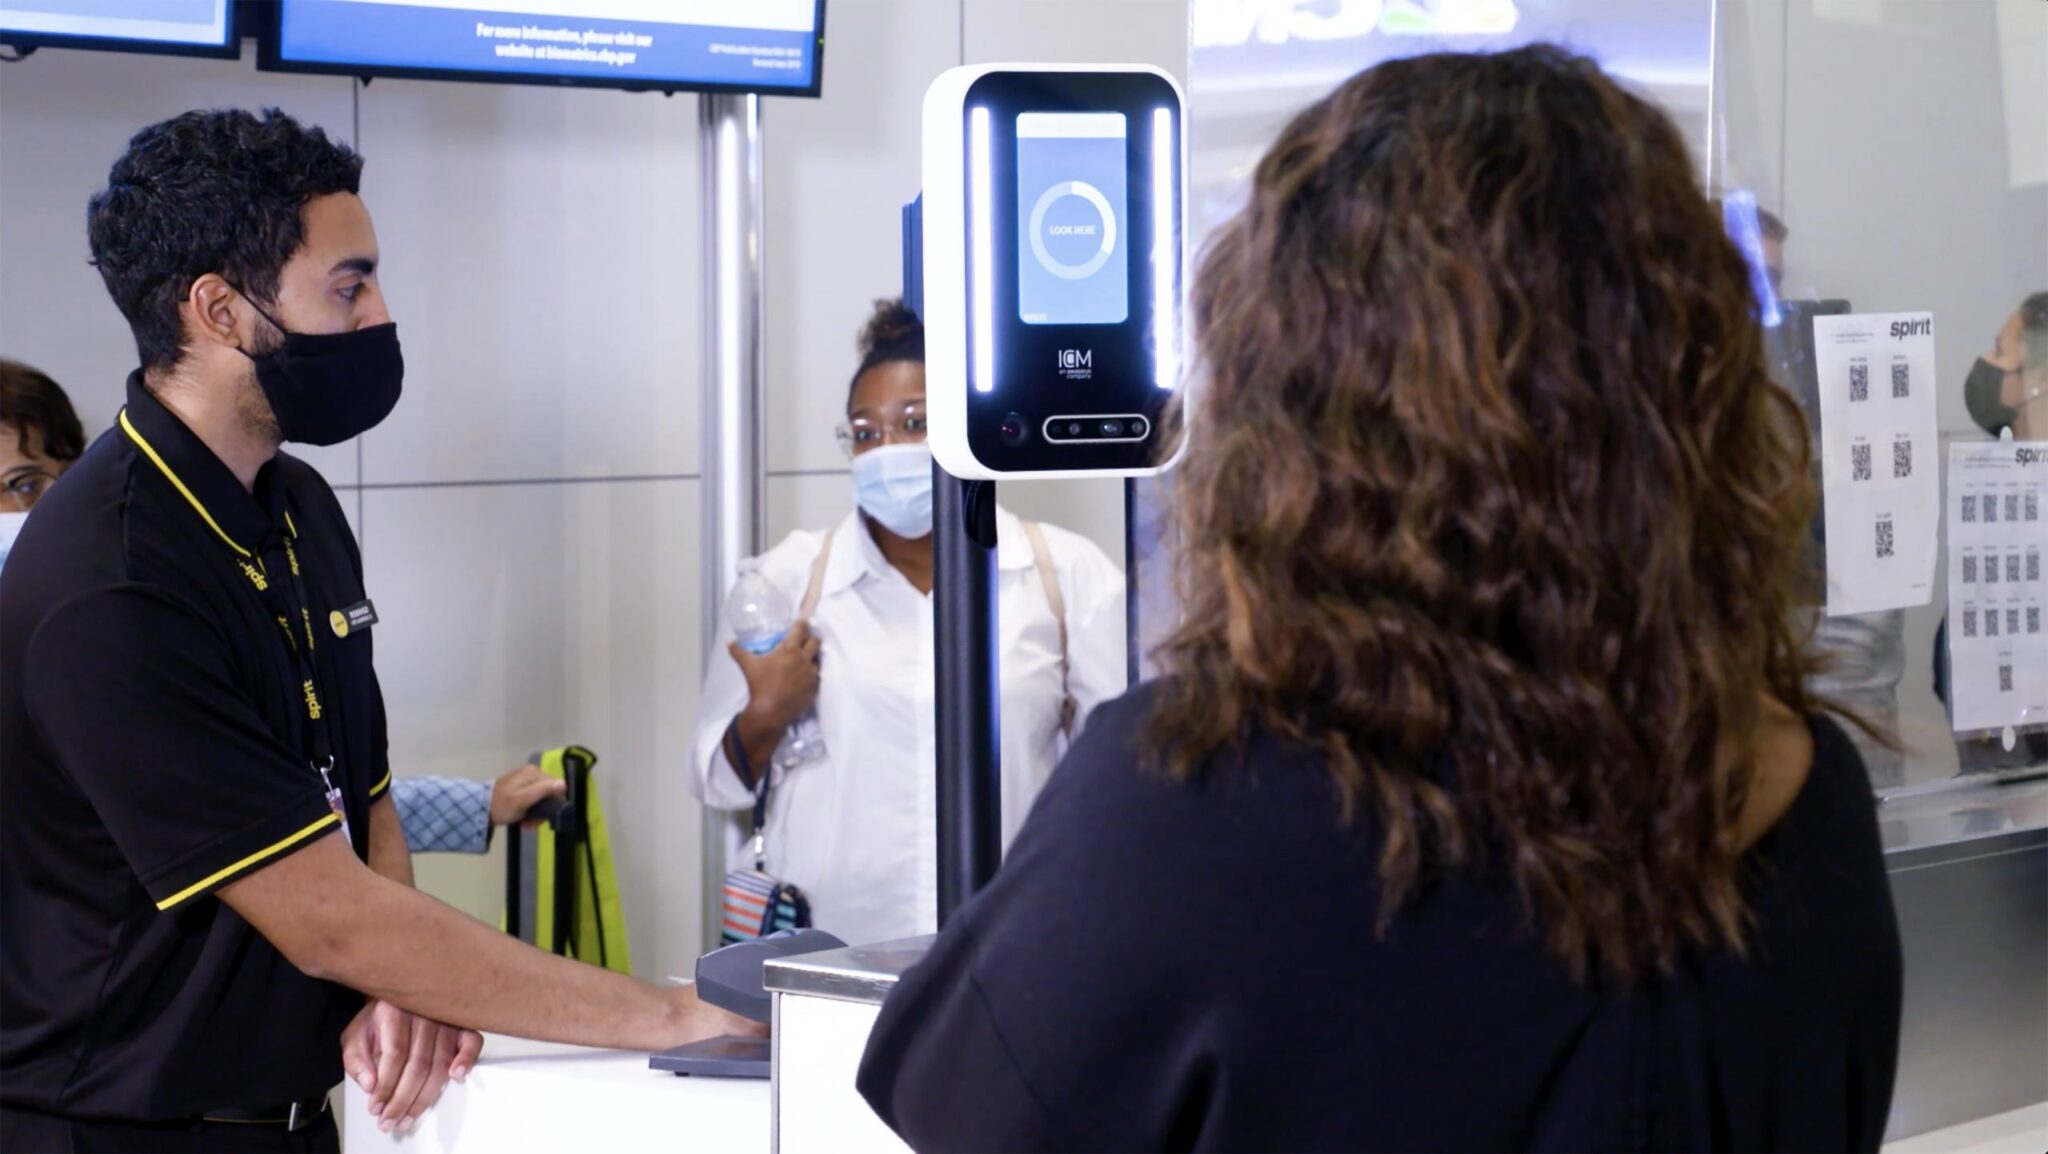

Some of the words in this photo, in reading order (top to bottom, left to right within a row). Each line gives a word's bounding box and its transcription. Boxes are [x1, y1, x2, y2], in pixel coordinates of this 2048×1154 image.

[1049, 225, 1073, 236] LOOK
[1073, 225, 1096, 236] HERE
[1890, 318, 1931, 340] spirit
[1059, 349, 1092, 368] ICM
[238, 559, 268, 590] spir
[303, 679, 322, 720] spirit
